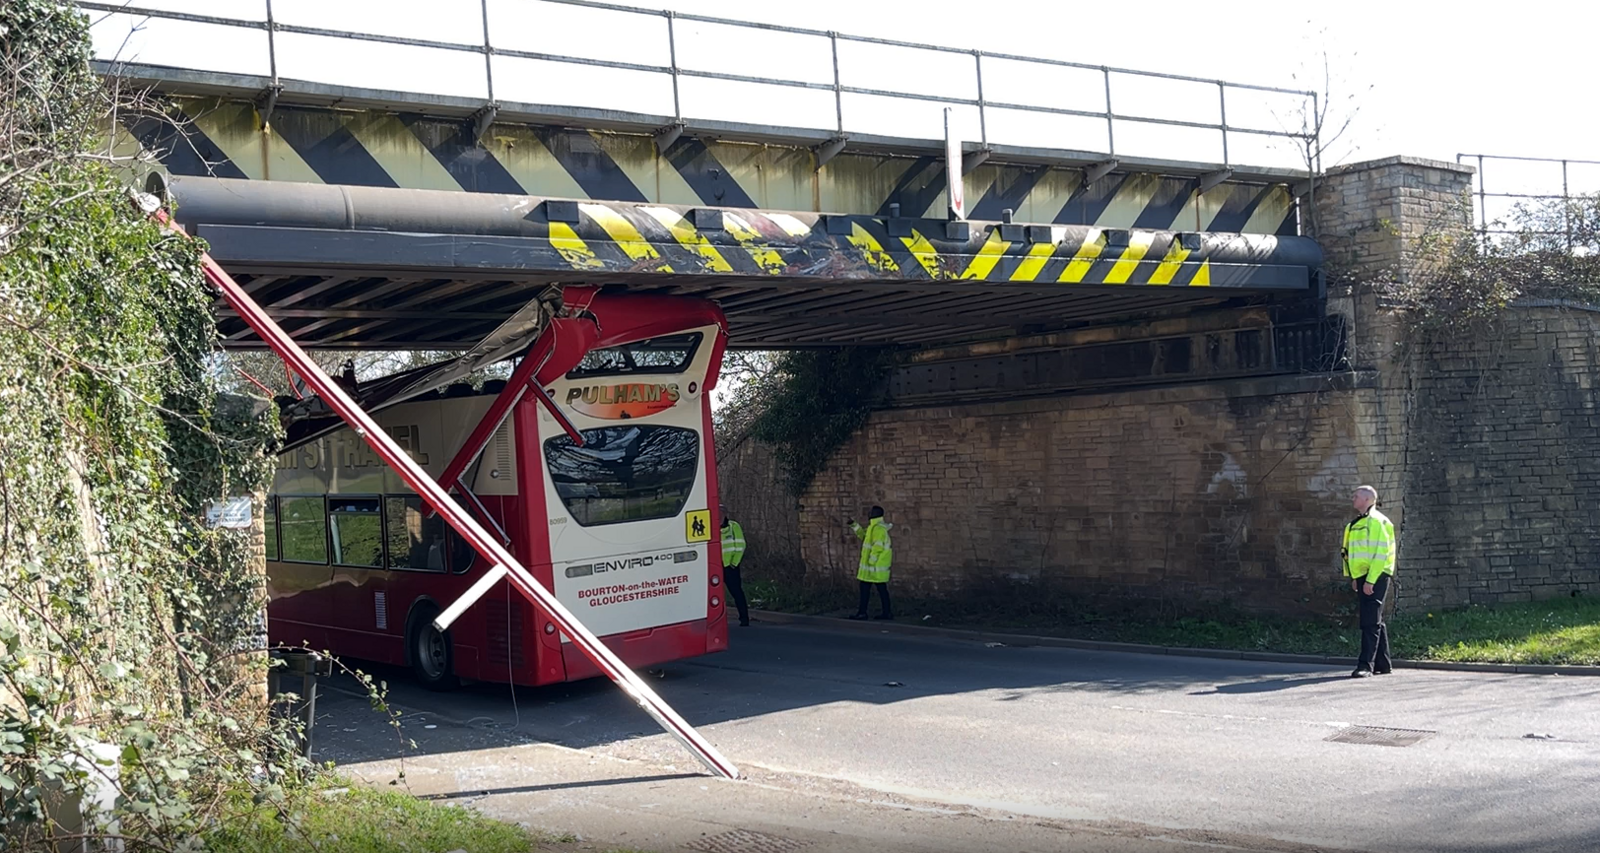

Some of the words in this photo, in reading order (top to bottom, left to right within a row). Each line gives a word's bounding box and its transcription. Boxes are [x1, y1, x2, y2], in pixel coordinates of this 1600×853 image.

[566, 383, 680, 405] PULHAM'S
[327, 425, 429, 468] TRAEL
[578, 575, 689, 599] BOURTON-on-the-WATER
[589, 586, 680, 607] GLOUCESTERSHIRE
